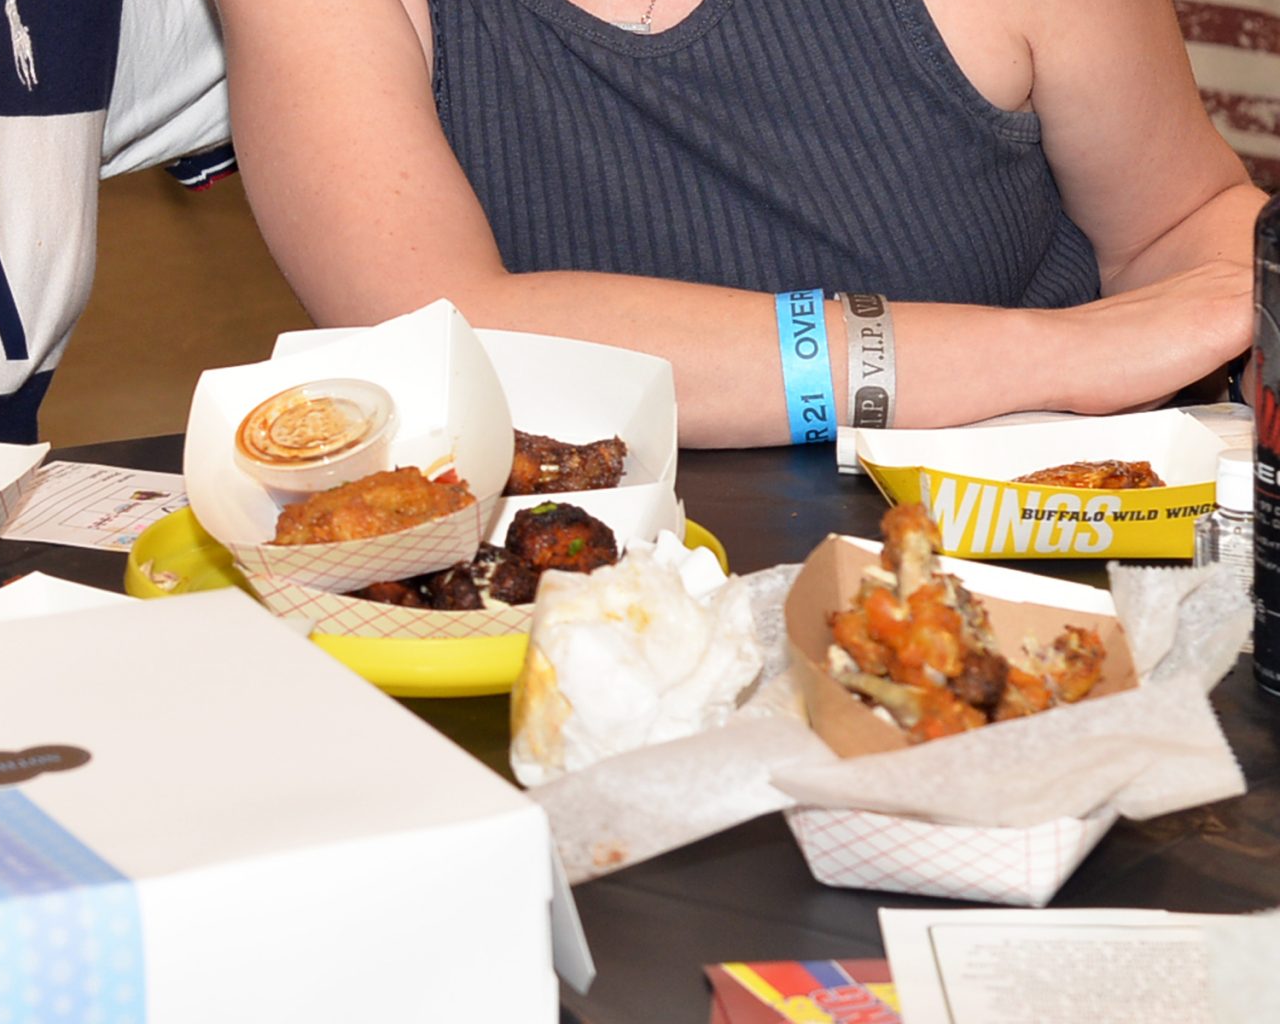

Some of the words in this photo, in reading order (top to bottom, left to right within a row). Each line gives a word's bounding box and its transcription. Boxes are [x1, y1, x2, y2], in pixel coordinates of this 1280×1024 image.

[860, 322, 885, 380] V.I.P.
[800, 392, 828, 423] 21
[929, 473, 1123, 554] WINGS
[1020, 506, 1106, 523] BUFFALO
[1111, 506, 1160, 522] WILD
[1166, 502, 1219, 520] WINGS
